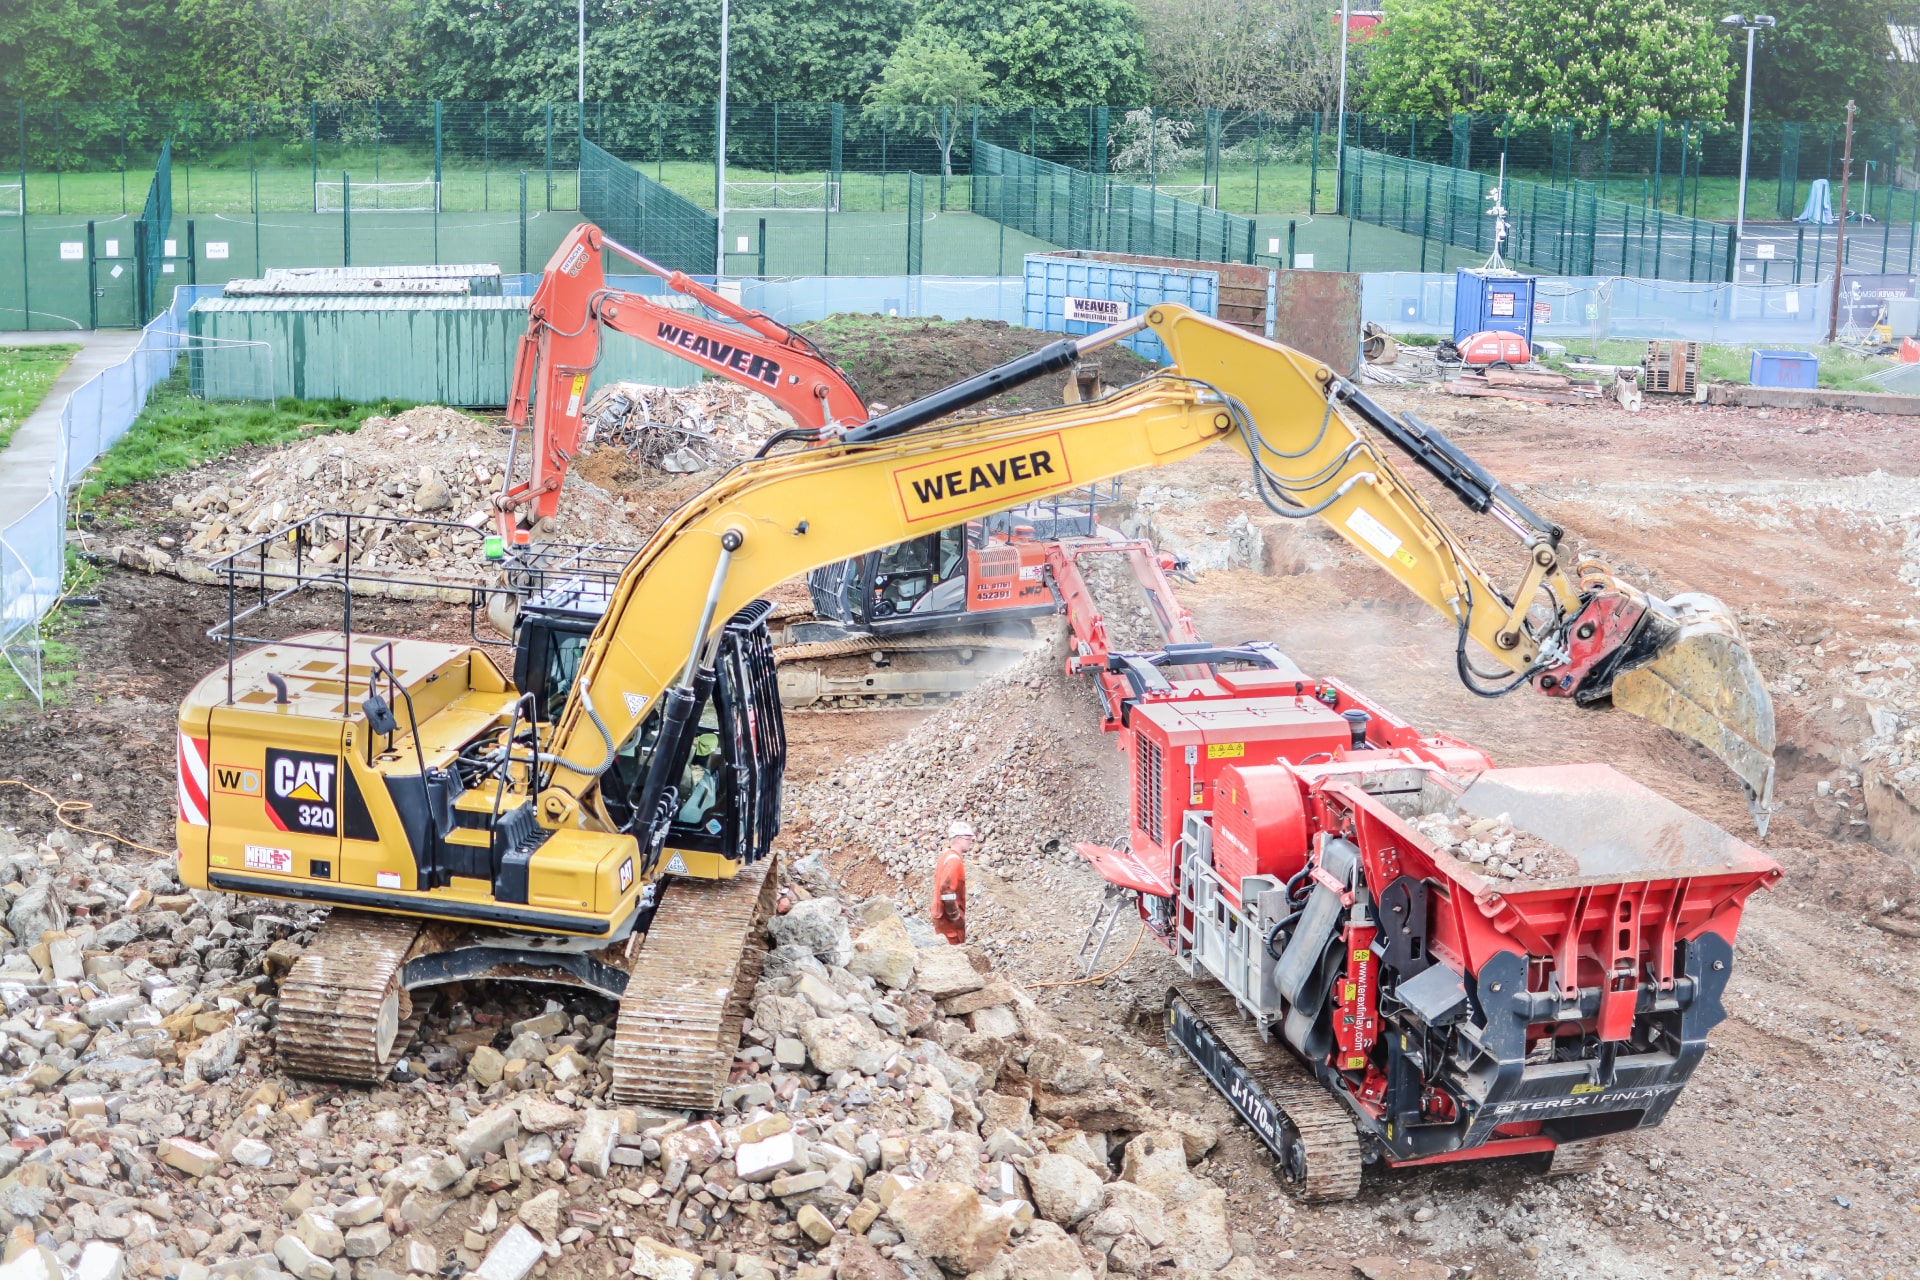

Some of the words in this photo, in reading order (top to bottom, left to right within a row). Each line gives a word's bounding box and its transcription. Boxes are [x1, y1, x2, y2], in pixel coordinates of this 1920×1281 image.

[562, 245, 582, 271] HITACHI
[1074, 299, 1118, 314] WEAVER
[657, 322, 782, 388] WEAVER
[912, 450, 1055, 504] WEAVER
[977, 590, 1011, 601] 452391
[217, 769, 259, 792] WD
[274, 757, 335, 803] CAT
[298, 804, 335, 829] 320
[620, 858, 633, 891] CAT
[1353, 961, 1368, 1052] www.terexfinlay.com
[1521, 1096, 1590, 1111] TEREX
[1600, 1089, 1665, 1102] FINLAY
